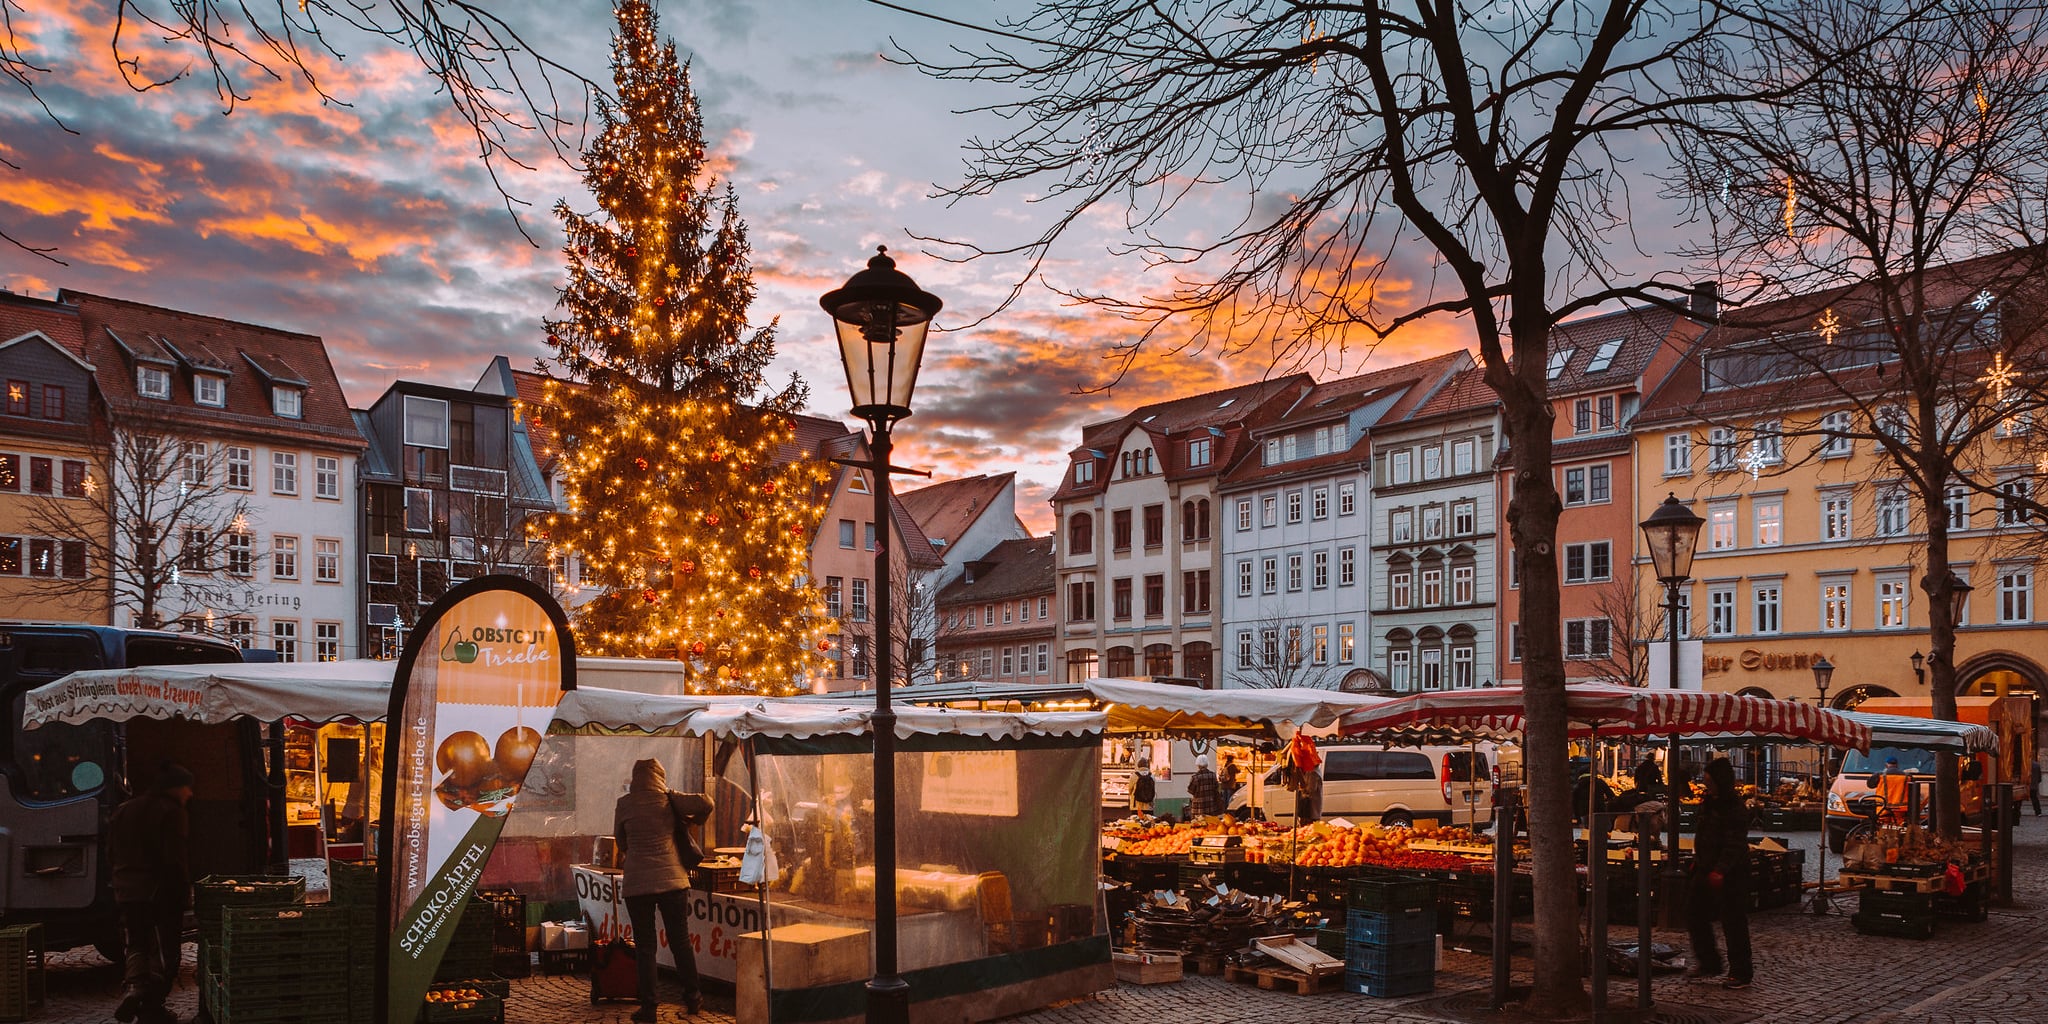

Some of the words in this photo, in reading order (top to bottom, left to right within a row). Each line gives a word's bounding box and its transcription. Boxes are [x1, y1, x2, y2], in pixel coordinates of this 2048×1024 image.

[245, 591, 301, 611] Hering
[480, 644, 551, 667] Triebe
[54, 692, 67, 706] aus
[407, 716, 427, 890] www.obstgut-triebe.de
[400, 843, 487, 952] SCHOKO-ÄPFEL
[411, 943, 425, 959] aus
[423, 913, 447, 944] eigener
[444, 868, 481, 913] Produktion
